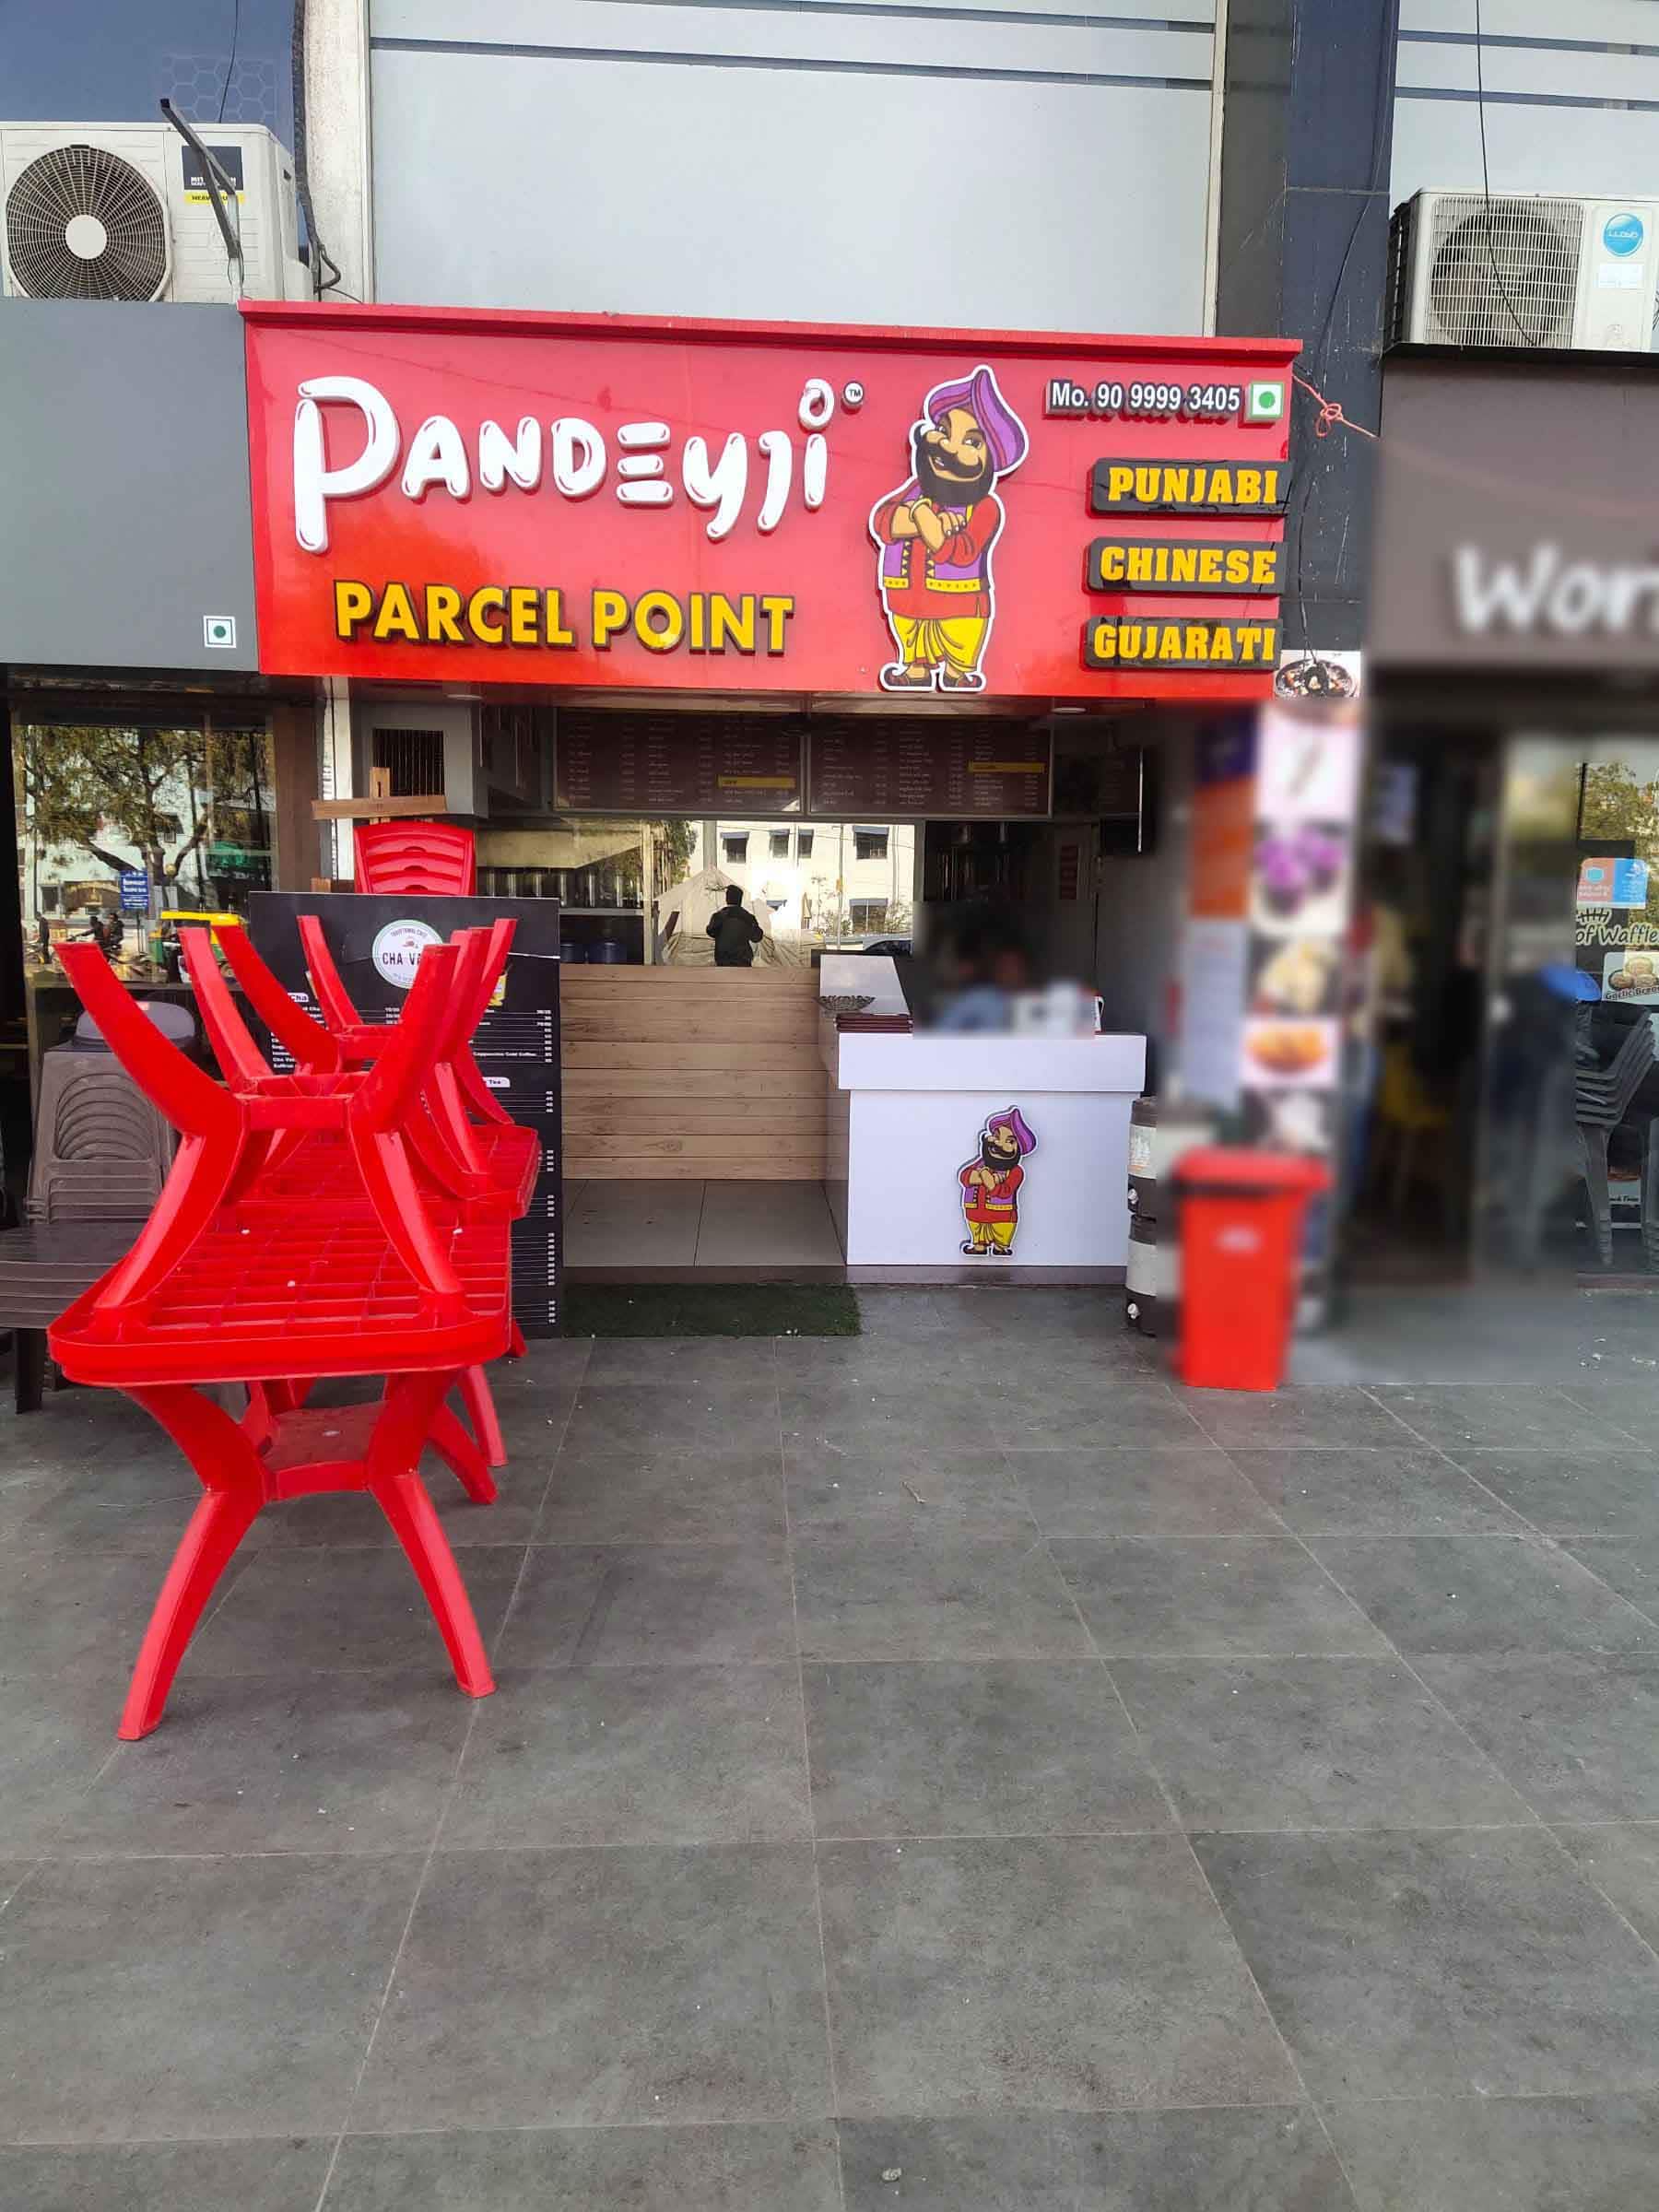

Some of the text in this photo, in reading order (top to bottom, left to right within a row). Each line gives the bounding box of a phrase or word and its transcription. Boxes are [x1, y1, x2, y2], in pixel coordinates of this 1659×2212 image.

[1051, 382, 1241, 412] Mo. 90 9999 3405
[1108, 466, 1279, 505] PUNJABI
[1100, 546, 1277, 585] CHINESE
[334, 579, 794, 656] PARCEL POINT
[1093, 623, 1277, 662] GUJARATI
[382, 952, 404, 965] CHA
